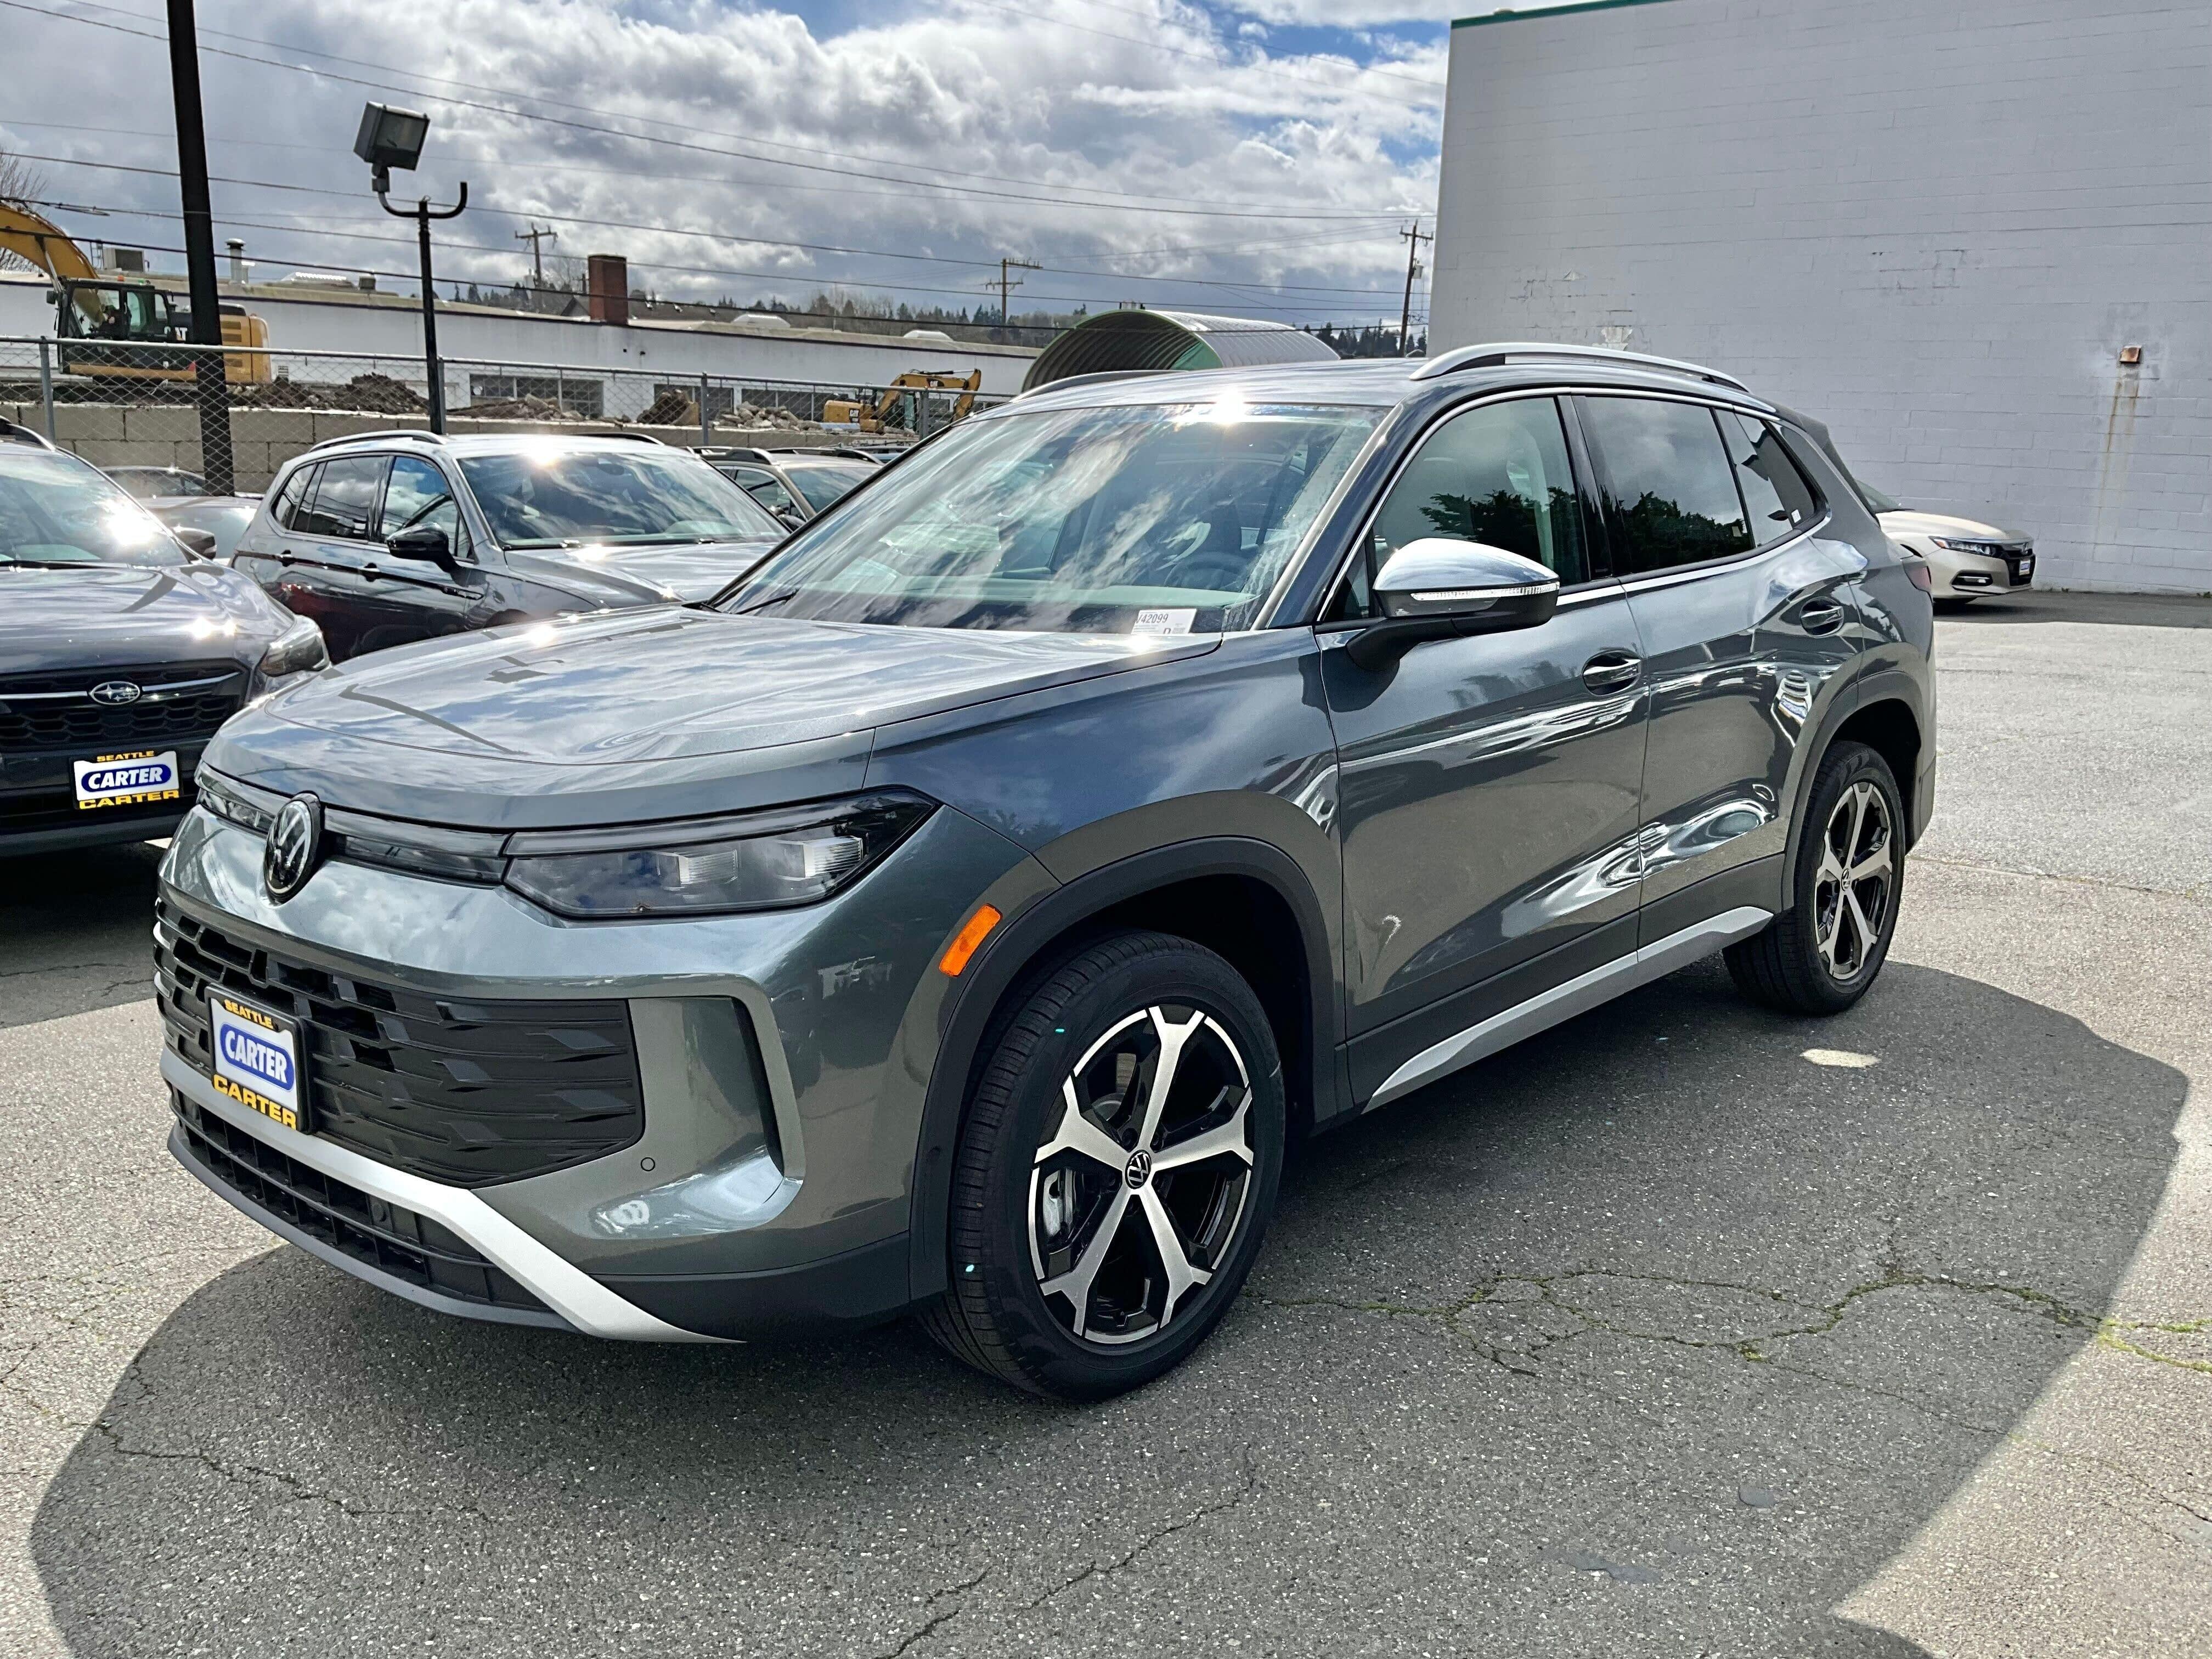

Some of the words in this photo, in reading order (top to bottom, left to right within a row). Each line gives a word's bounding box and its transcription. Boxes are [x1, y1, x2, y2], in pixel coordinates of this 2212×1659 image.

[97, 751, 154, 762] SEATTLE
[88, 767, 163, 789] CARTER
[79, 789, 179, 809] CARTER
[224, 999, 274, 1029] SEATTLE
[225, 1030, 287, 1084] CARTER
[213, 1074, 297, 1130] CARTER
